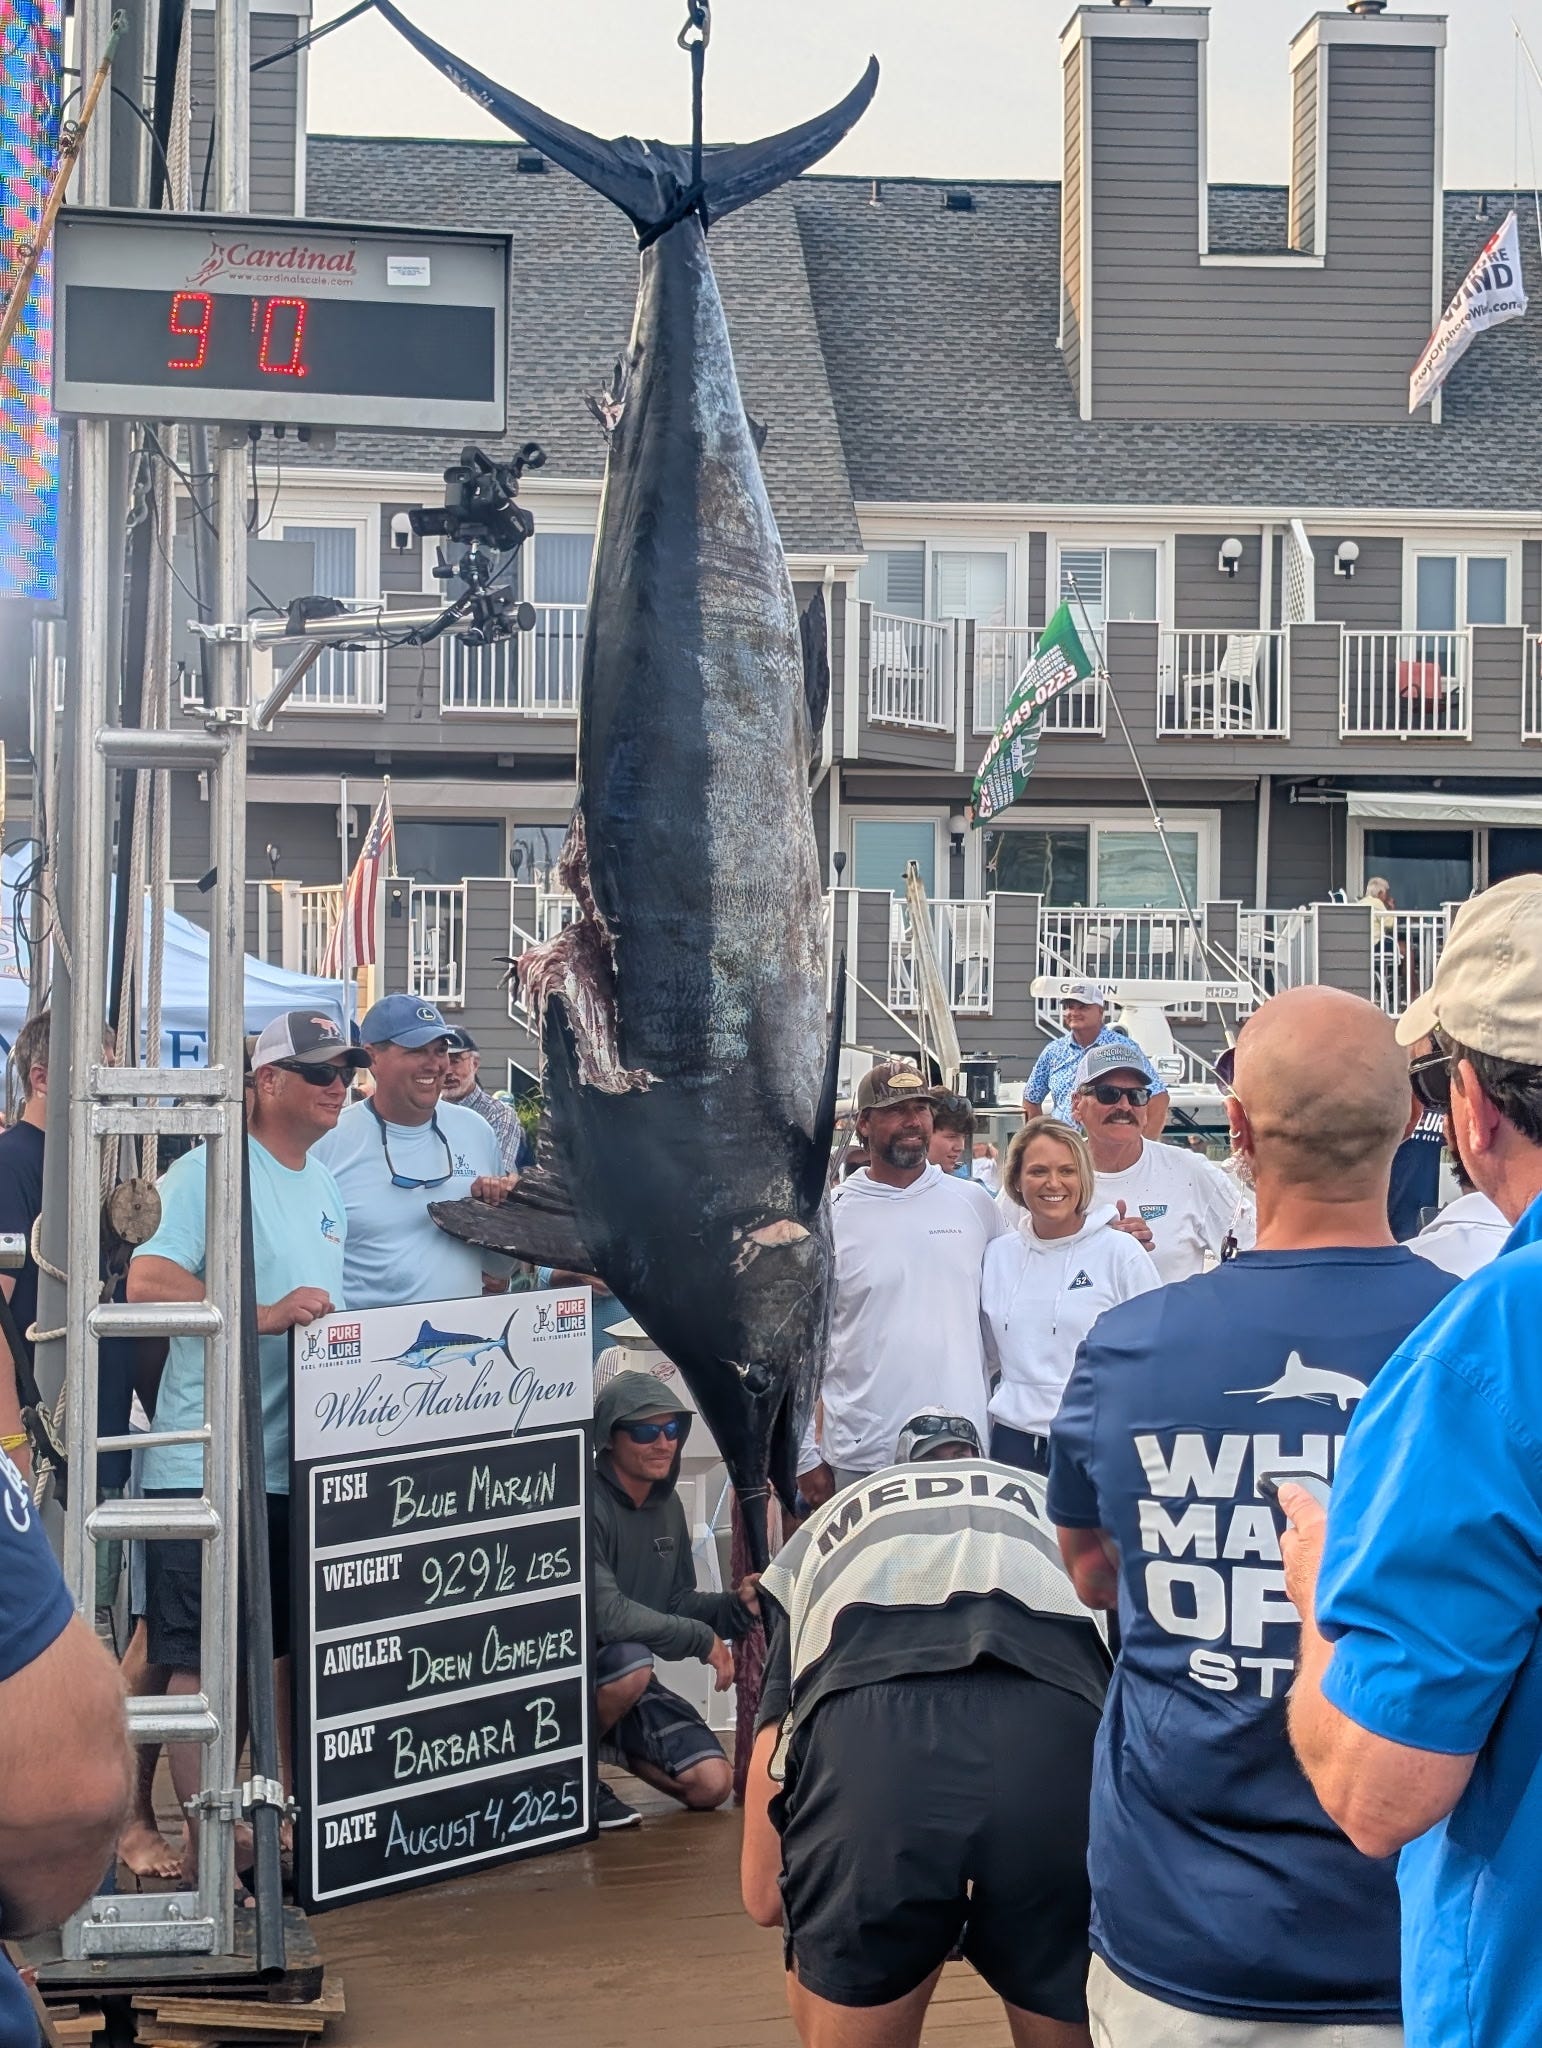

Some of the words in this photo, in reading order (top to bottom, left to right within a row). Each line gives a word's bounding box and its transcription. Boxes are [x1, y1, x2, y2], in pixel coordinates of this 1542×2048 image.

[226, 243, 356, 271] Cardinal
[229, 273, 353, 286] www.cardinalscale.com
[1441, 263, 1513, 322] WIND
[1415, 1112, 1444, 1133] LUR
[557, 1300, 585, 1315] PURE
[557, 1316, 585, 1331] LURE
[329, 1325, 360, 1341] PURE
[329, 1342, 360, 1359] LURE
[316, 1373, 401, 1432] White
[377, 1360, 503, 1437] Marlin
[508, 1366, 578, 1437] Open
[322, 1472, 368, 1504] FISH
[387, 1476, 458, 1528] BLUE
[816, 1474, 1040, 1557] MEDIA
[322, 1553, 403, 1592] WEIGHT
[525, 1546, 572, 1583] LBS
[323, 1636, 403, 1676] ANGLER
[407, 1647, 473, 1691] DREW
[481, 1625, 577, 1675] OSMEYER
[323, 1725, 376, 1761] BOAT
[388, 1719, 516, 1779] BARBARA
[525, 1697, 560, 1749] B
[325, 1811, 377, 1849] DATE
[384, 1810, 480, 1858] AUGUST
